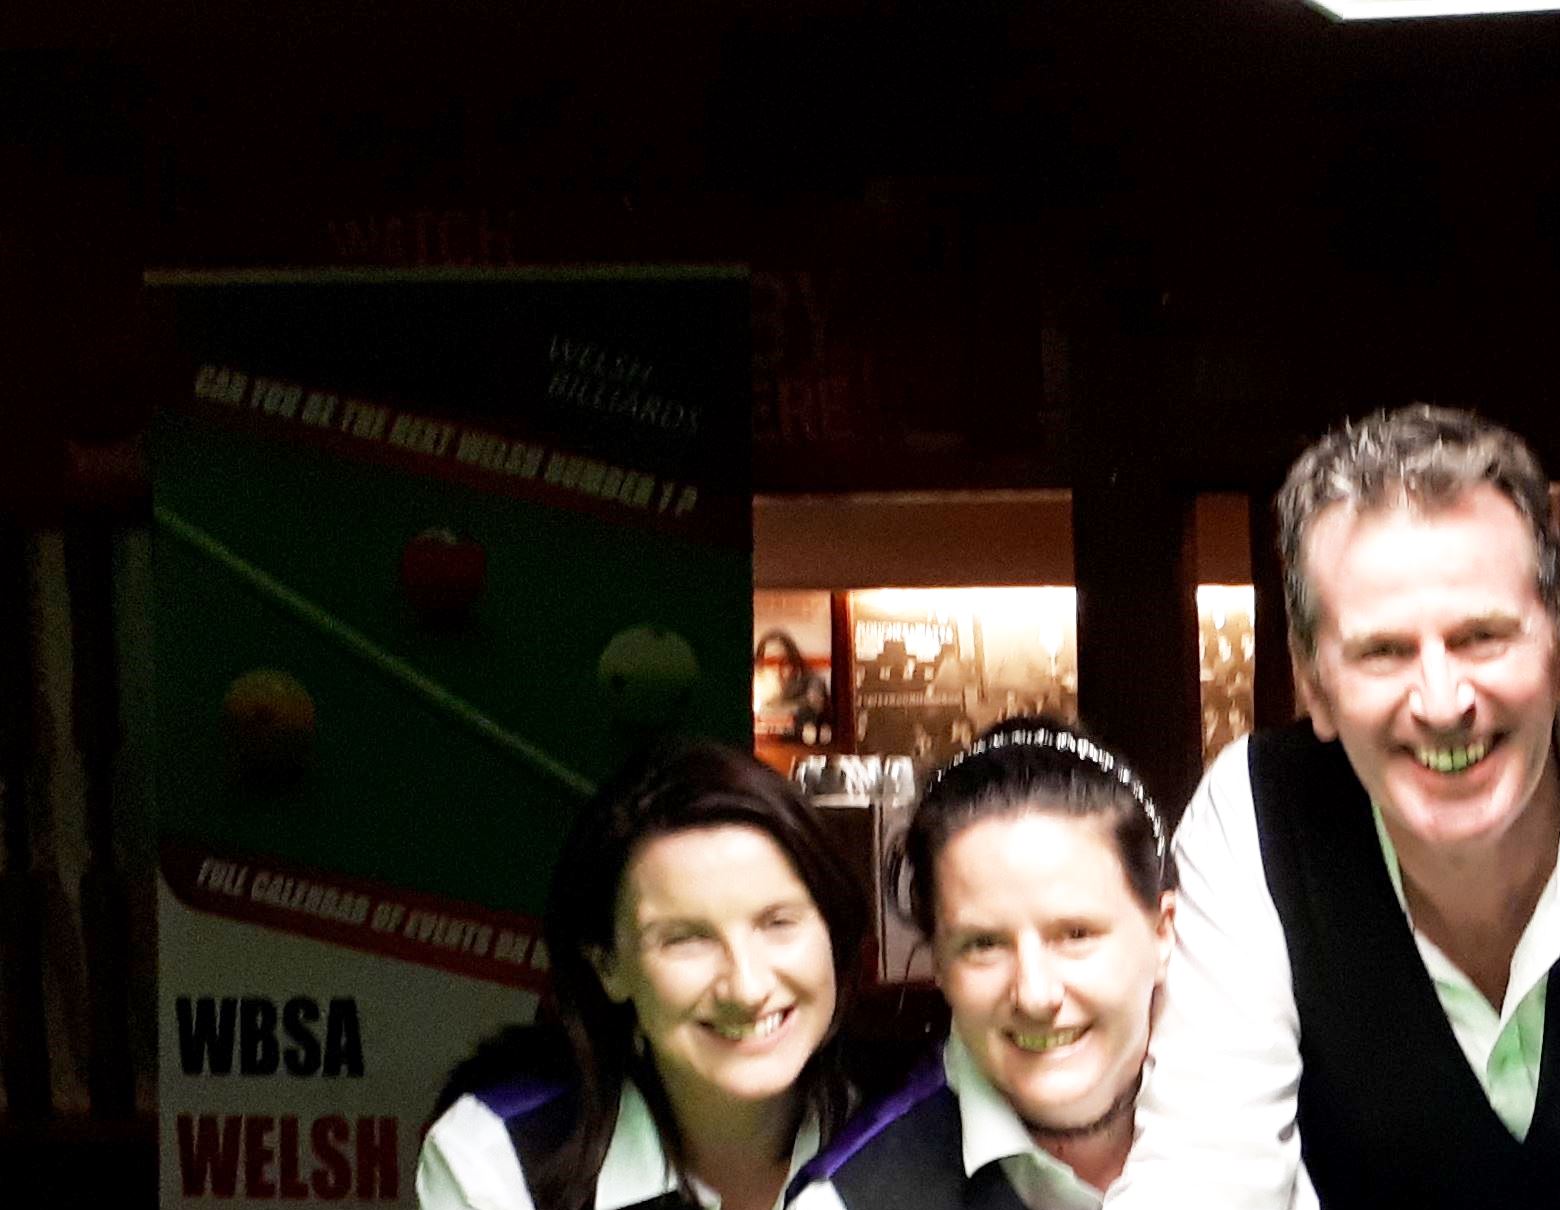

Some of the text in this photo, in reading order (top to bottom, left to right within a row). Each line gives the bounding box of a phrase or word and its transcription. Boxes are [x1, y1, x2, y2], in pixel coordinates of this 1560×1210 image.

[457, 431, 545, 478] WELSH
[198, 856, 249, 897] FULL
[250, 871, 373, 925] CALENDAR
[403, 907, 494, 956] EVENTS
[177, 998, 364, 1078] WBSA
[178, 1115, 398, 1199] WELSH
